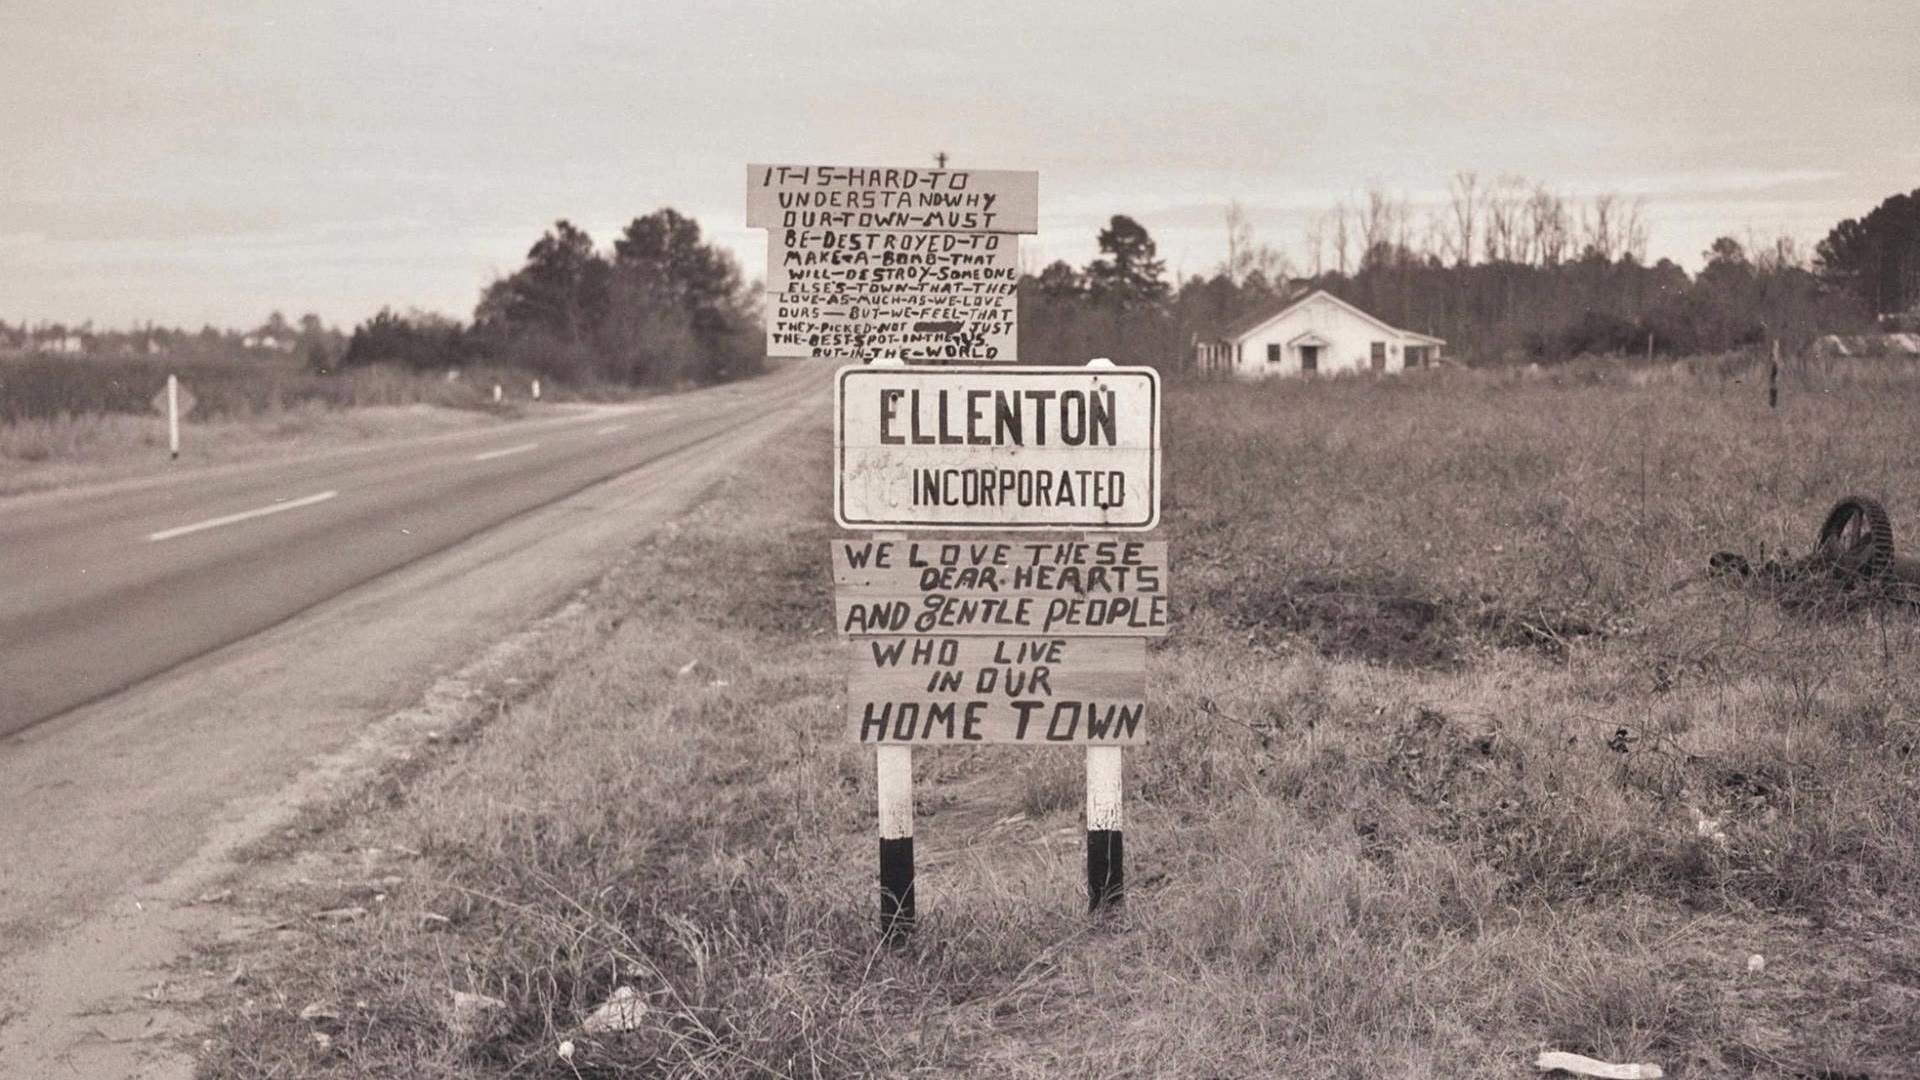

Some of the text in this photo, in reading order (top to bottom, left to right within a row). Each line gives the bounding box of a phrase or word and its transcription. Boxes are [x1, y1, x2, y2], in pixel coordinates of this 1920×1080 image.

[969, 322, 1013, 335] JUST
[880, 389, 1117, 446] ELLENTON
[913, 469, 1125, 507] INCORPORATED
[845, 542, 1144, 568] WE LOVE THESE
[1014, 566, 1158, 594] HEARTS
[845, 601, 910, 633] AND
[1043, 596, 1168, 633] PEOPLE
[872, 639, 1066, 667] WHO LIVE
[927, 666, 1052, 697] IN OUR
[860, 701, 1143, 741] HOME TOWN
